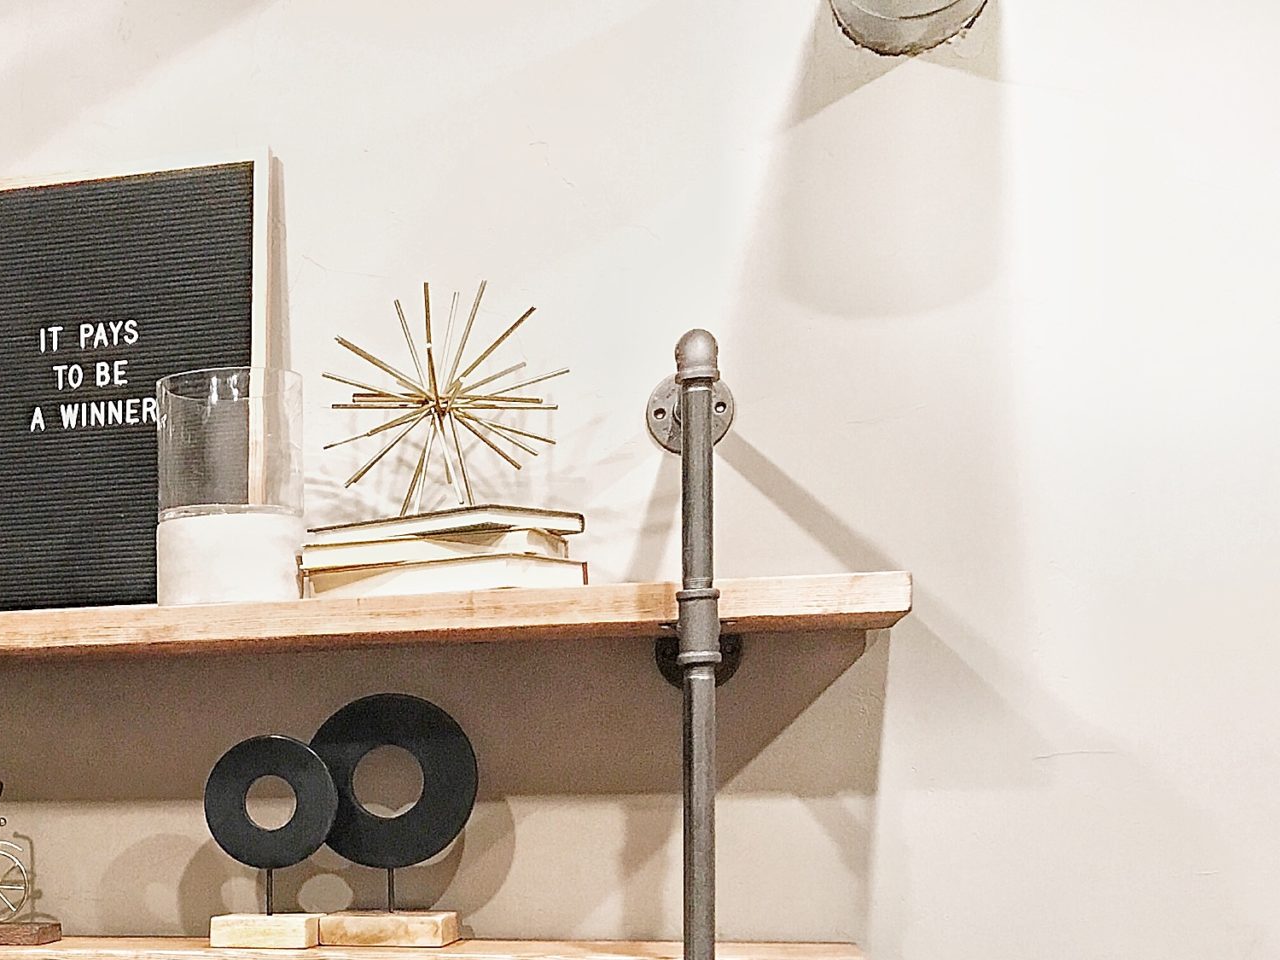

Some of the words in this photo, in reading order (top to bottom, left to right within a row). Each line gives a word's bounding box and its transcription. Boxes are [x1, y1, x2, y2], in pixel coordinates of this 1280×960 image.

[39, 326, 64, 353] IT
[79, 320, 139, 349] PAYS
[52, 364, 84, 391] TO
[96, 359, 129, 388] BE
[30, 406, 45, 432] A
[60, 397, 157, 430] WINNER
